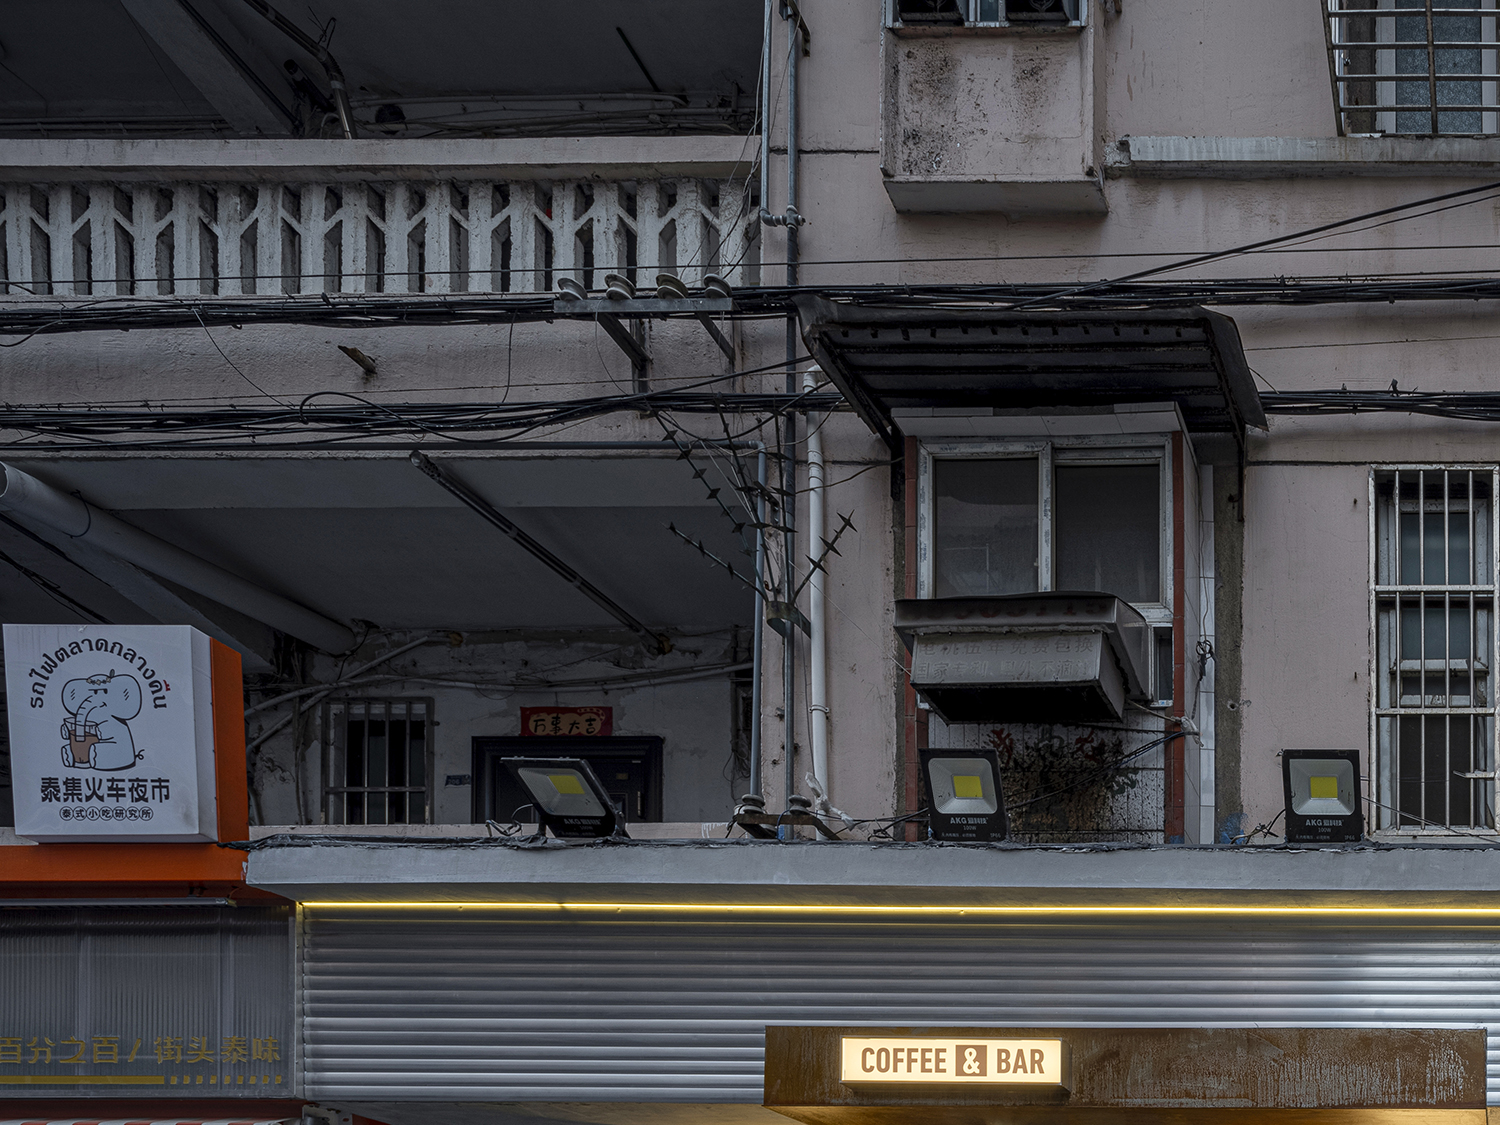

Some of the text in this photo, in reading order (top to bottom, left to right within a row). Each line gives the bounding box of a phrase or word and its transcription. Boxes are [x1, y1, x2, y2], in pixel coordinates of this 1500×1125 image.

[533, 713, 597, 735] 万事大吉
[40, 776, 170, 803] 泰集火车夜市
[60, 806, 153, 820] 泰式小吃研究所
[154, 1036, 281, 1065] 街头泰味
[861, 1047, 1045, 1074] COFFEE & BAR
